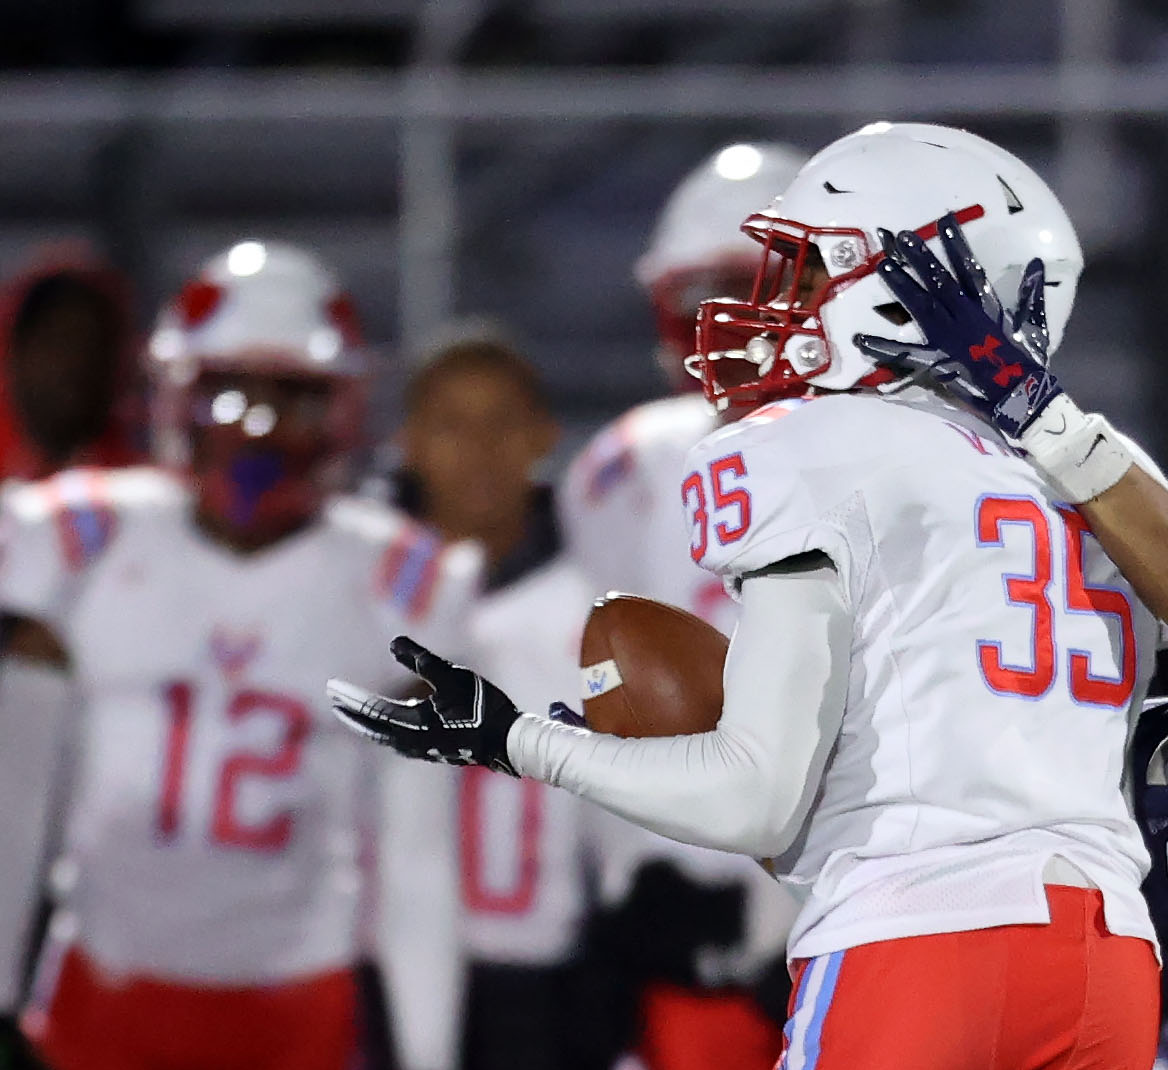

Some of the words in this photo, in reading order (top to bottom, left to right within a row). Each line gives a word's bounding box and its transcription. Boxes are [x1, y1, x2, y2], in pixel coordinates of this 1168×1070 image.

[681, 450, 752, 563] 35
[974, 493, 1137, 711] 35
[155, 680, 310, 854] 12
